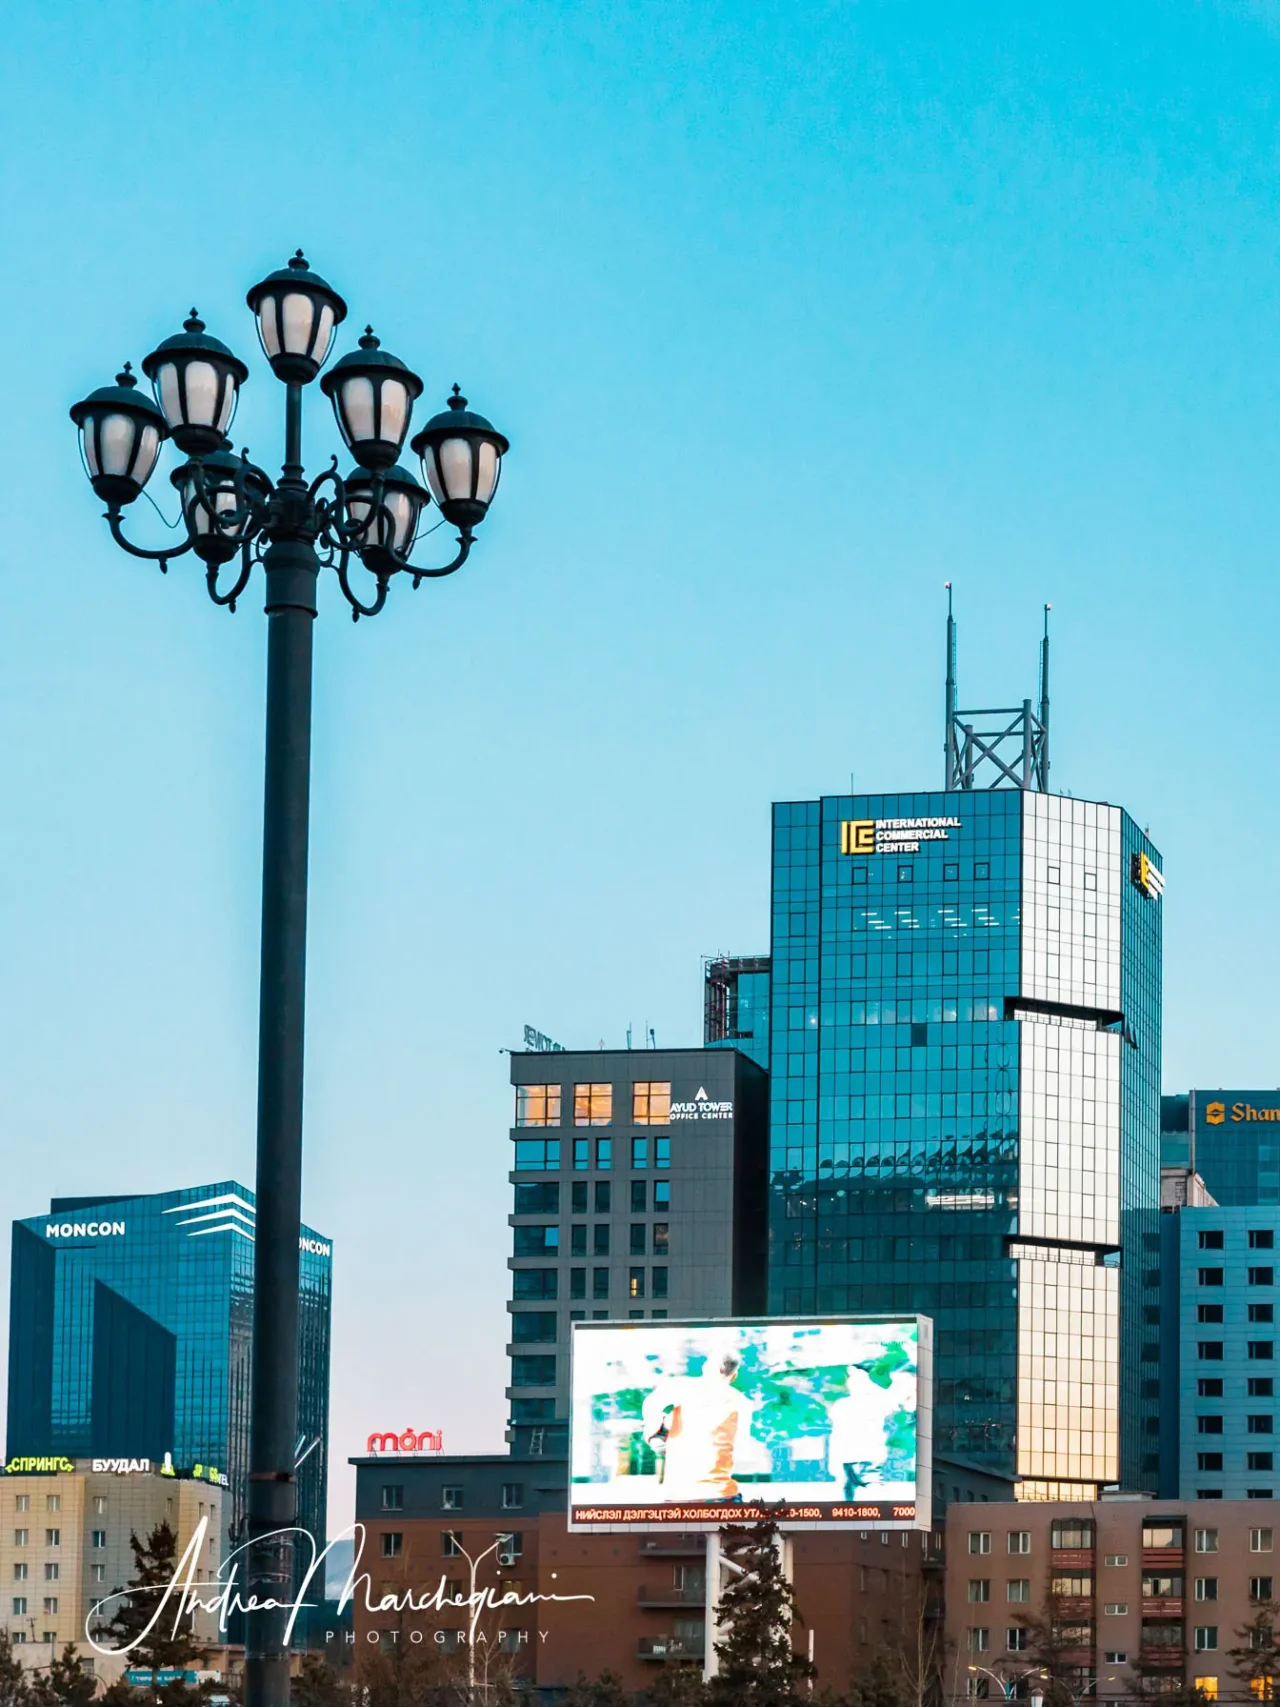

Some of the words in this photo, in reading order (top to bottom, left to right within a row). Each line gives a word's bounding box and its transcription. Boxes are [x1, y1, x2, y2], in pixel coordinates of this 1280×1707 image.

[875, 817, 962, 829] INTERNATIONAL
[876, 829, 949, 841] COMMERCIAL
[876, 842, 920, 853] CENTER
[670, 1102, 697, 1112] AYUD
[698, 1102, 733, 1112] TOWER
[670, 1112, 699, 1120] OFFICE
[46, 1221, 126, 1238] MONCON
[299, 1236, 330, 1257] NCON
[12, 1457, 68, 1472] СПРИНГС
[92, 1459, 150, 1474] БУУДАЛ
[576, 1508, 621, 1520] НИЙСЛЭЛ
[623, 1508, 681, 1521] ДЭЛГЭЦТЭЙ
[682, 1508, 742, 1519] ХОЛБОГДОХ
[893, 1507, 916, 1516] 7000
